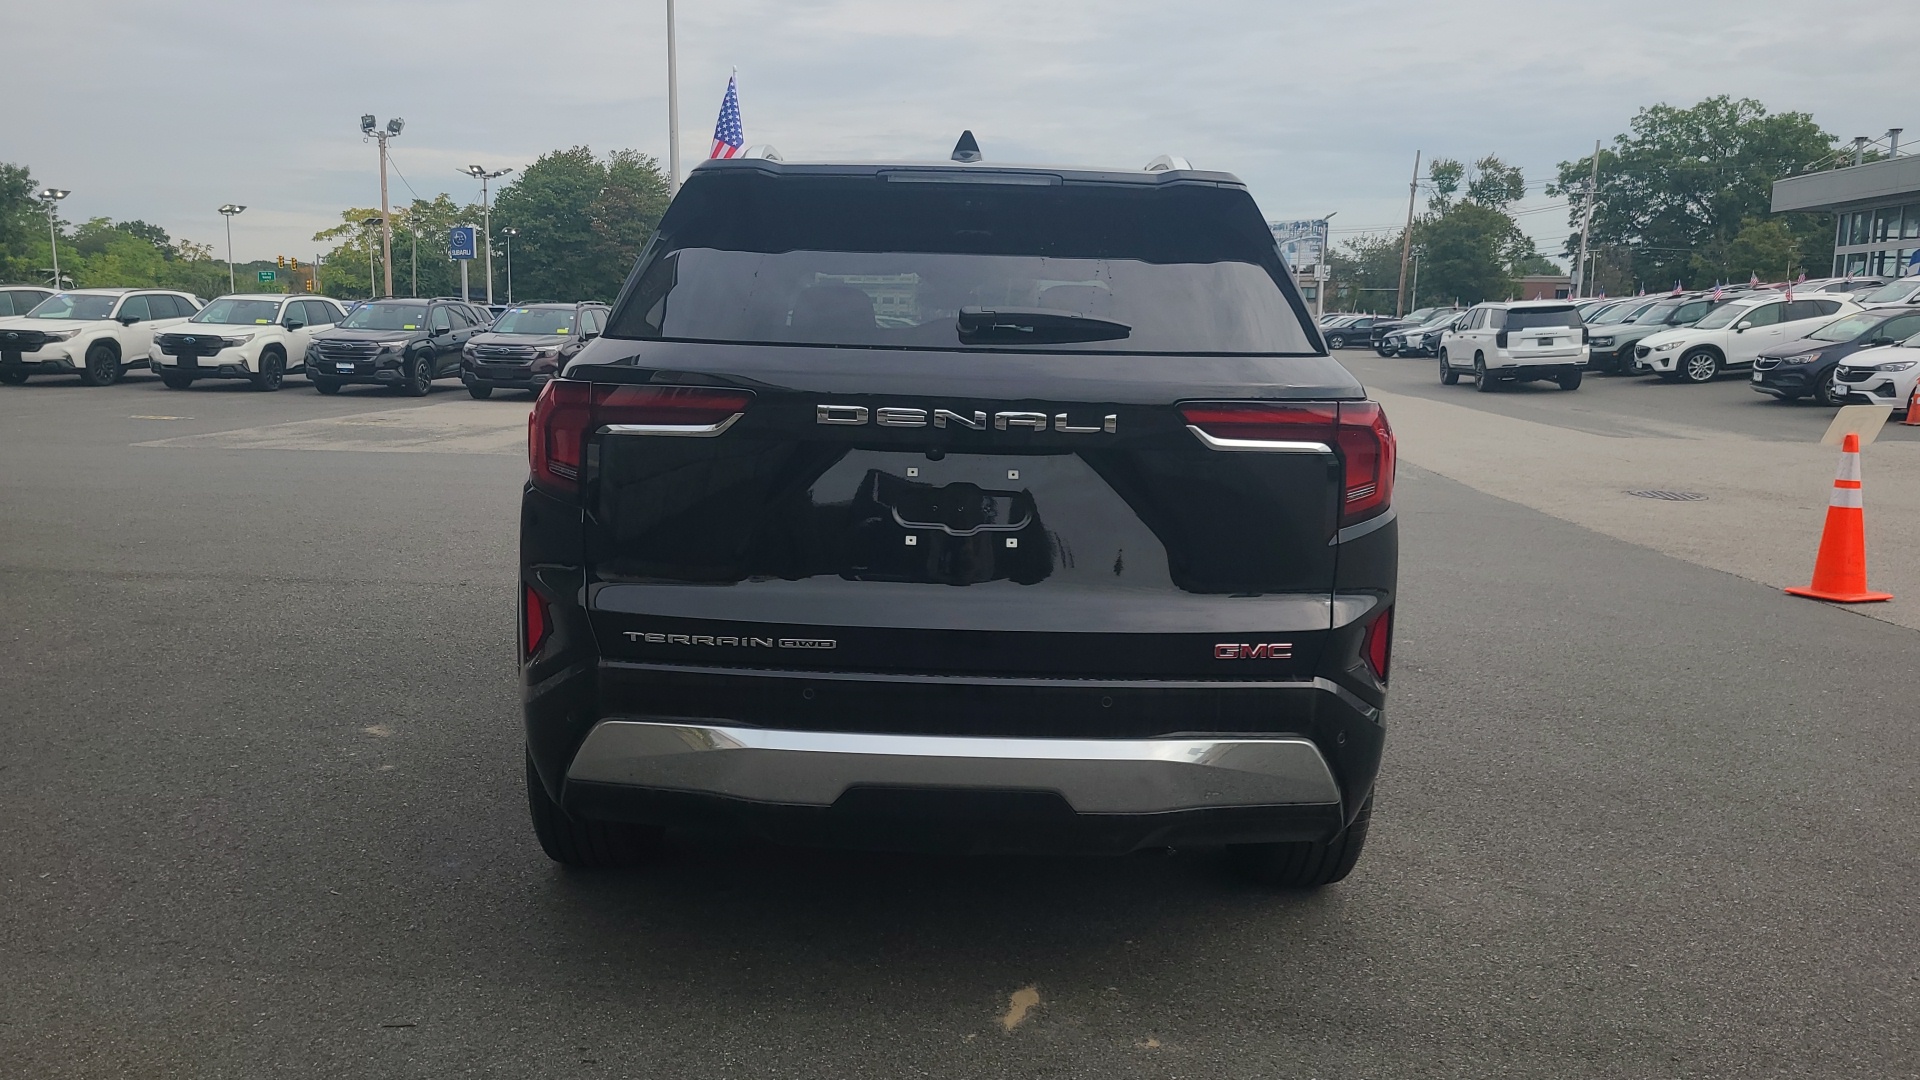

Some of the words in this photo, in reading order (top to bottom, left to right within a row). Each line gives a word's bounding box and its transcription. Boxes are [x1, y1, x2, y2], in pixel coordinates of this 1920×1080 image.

[816, 404, 1117, 433] DENALI
[622, 631, 773, 648] TERRAIN
[778, 638, 837, 649] AWD
[1214, 643, 1293, 659] GMC
